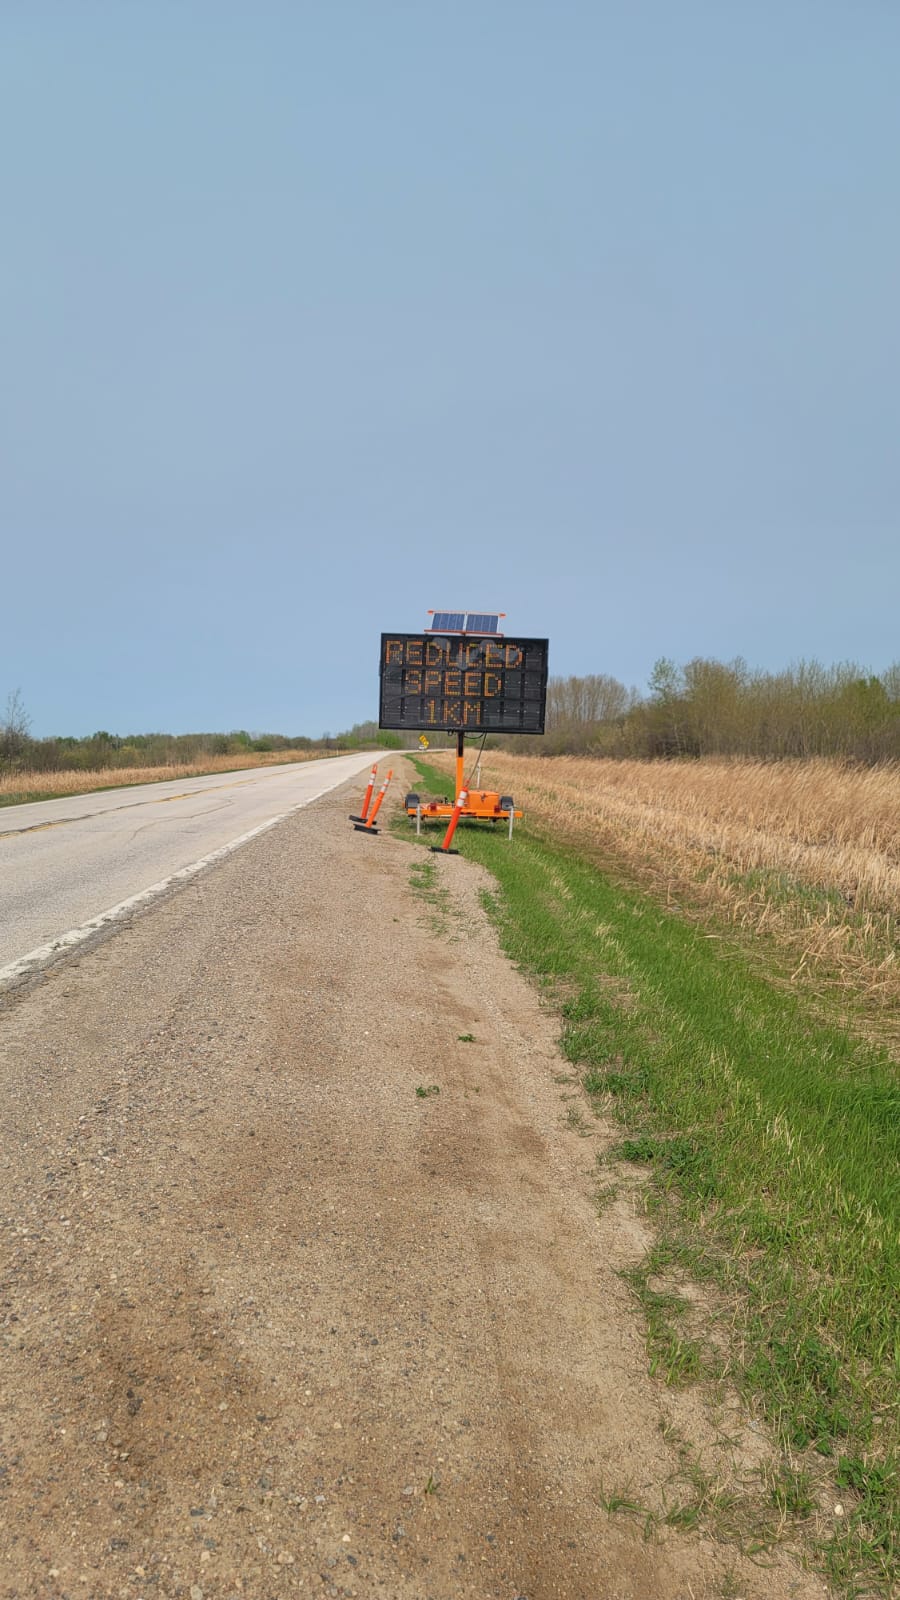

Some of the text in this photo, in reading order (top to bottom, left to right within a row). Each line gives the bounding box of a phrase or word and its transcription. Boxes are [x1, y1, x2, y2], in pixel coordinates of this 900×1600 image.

[385, 640, 523, 669] REDUCED
[405, 669, 502, 697] SPEED
[426, 699, 481, 725] 1KM
